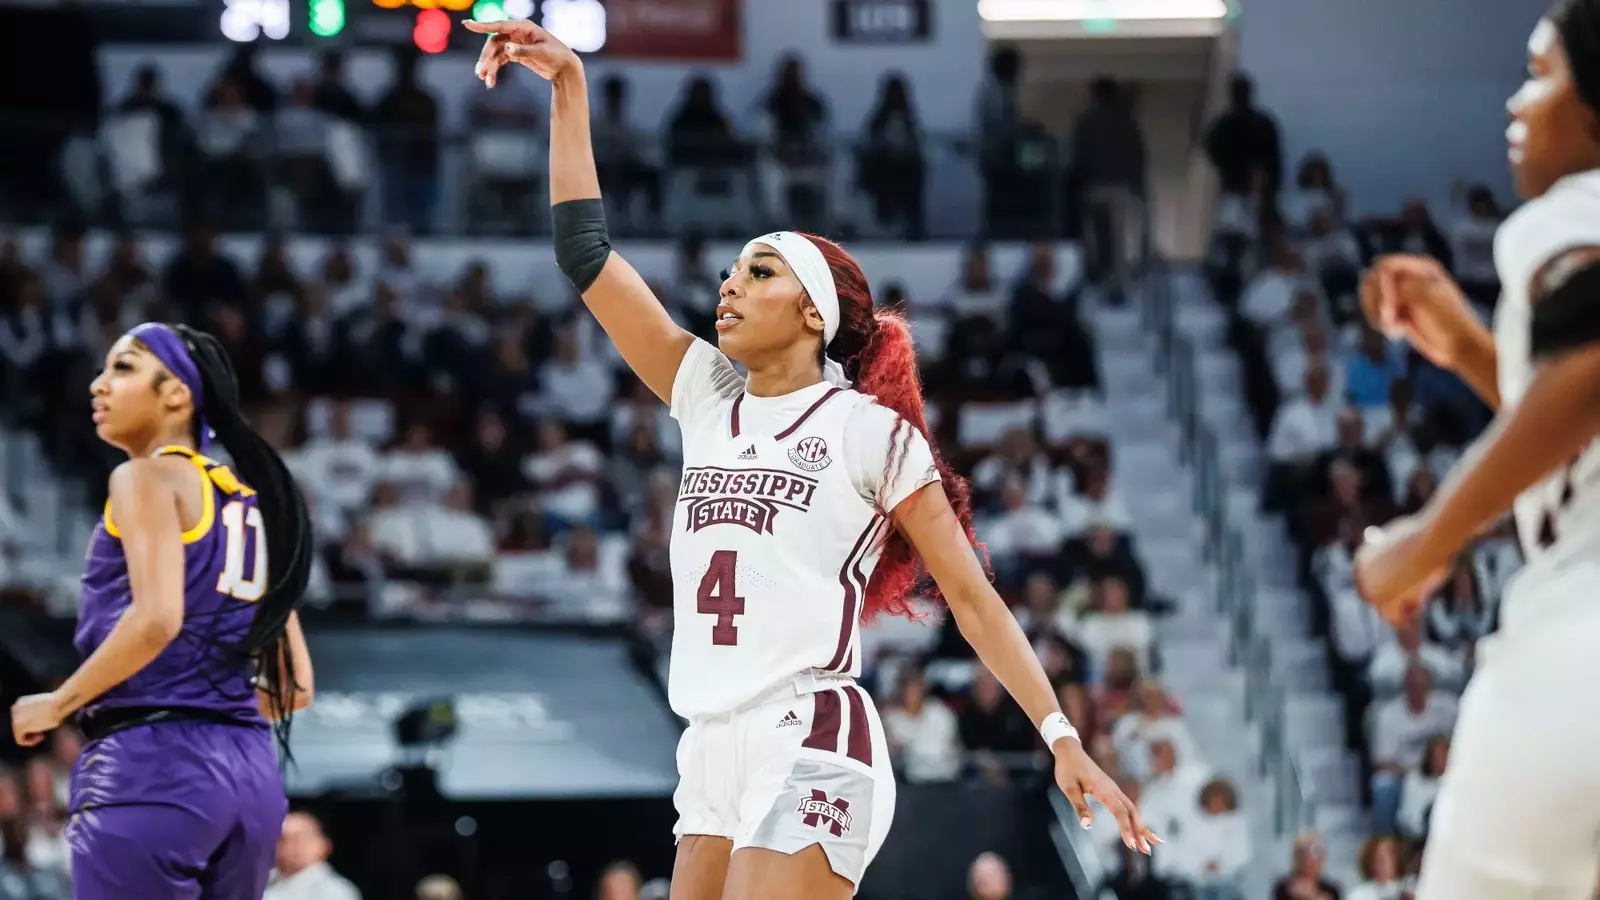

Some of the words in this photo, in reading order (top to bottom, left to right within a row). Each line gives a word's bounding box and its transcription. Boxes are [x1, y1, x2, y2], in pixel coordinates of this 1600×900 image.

[797, 437, 827, 462] SEC
[680, 471, 817, 507] MISSISSIPPI
[698, 501, 759, 527] STATE
[697, 550, 745, 646] 4
[775, 719, 803, 729] adidas
[808, 801, 845, 825] STATE
